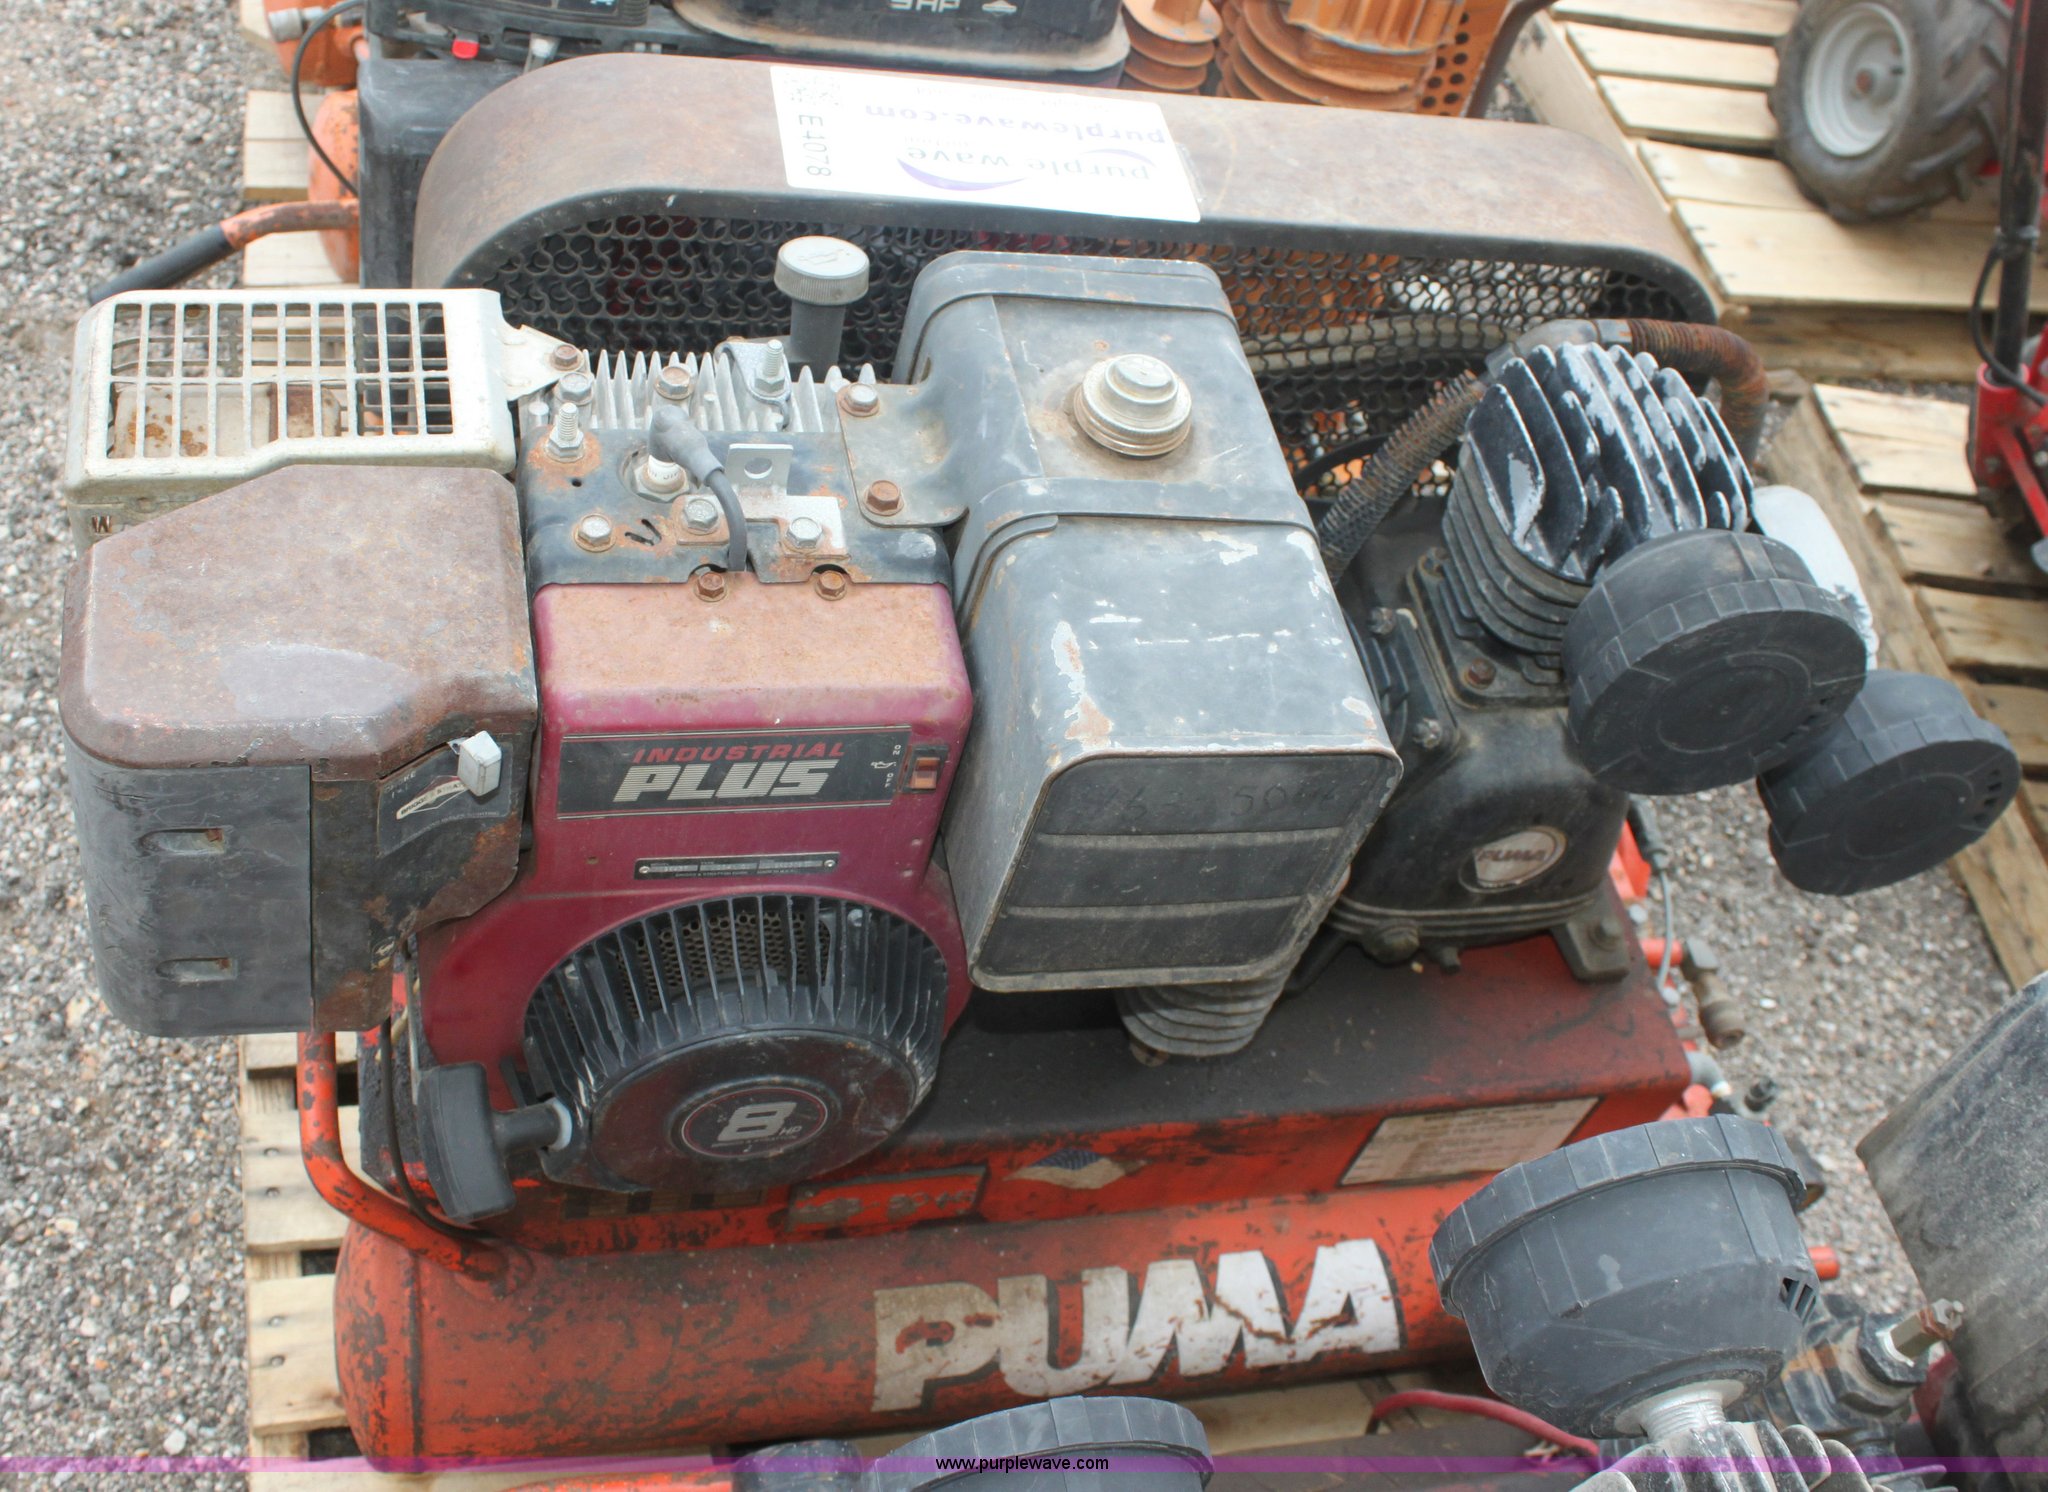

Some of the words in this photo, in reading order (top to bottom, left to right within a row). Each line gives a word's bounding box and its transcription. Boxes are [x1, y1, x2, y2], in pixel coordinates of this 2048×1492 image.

[865, 104, 1166, 144] purplewave.com
[907, 146, 1010, 168] wave
[1028, 155, 1150, 181] purple
[632, 742, 845, 764] INDUSTRIAL
[612, 759, 840, 802] PLUS
[717, 1101, 798, 1142] 8
[779, 1125, 802, 1136] HP
[873, 1238, 1400, 1412] PUMA
